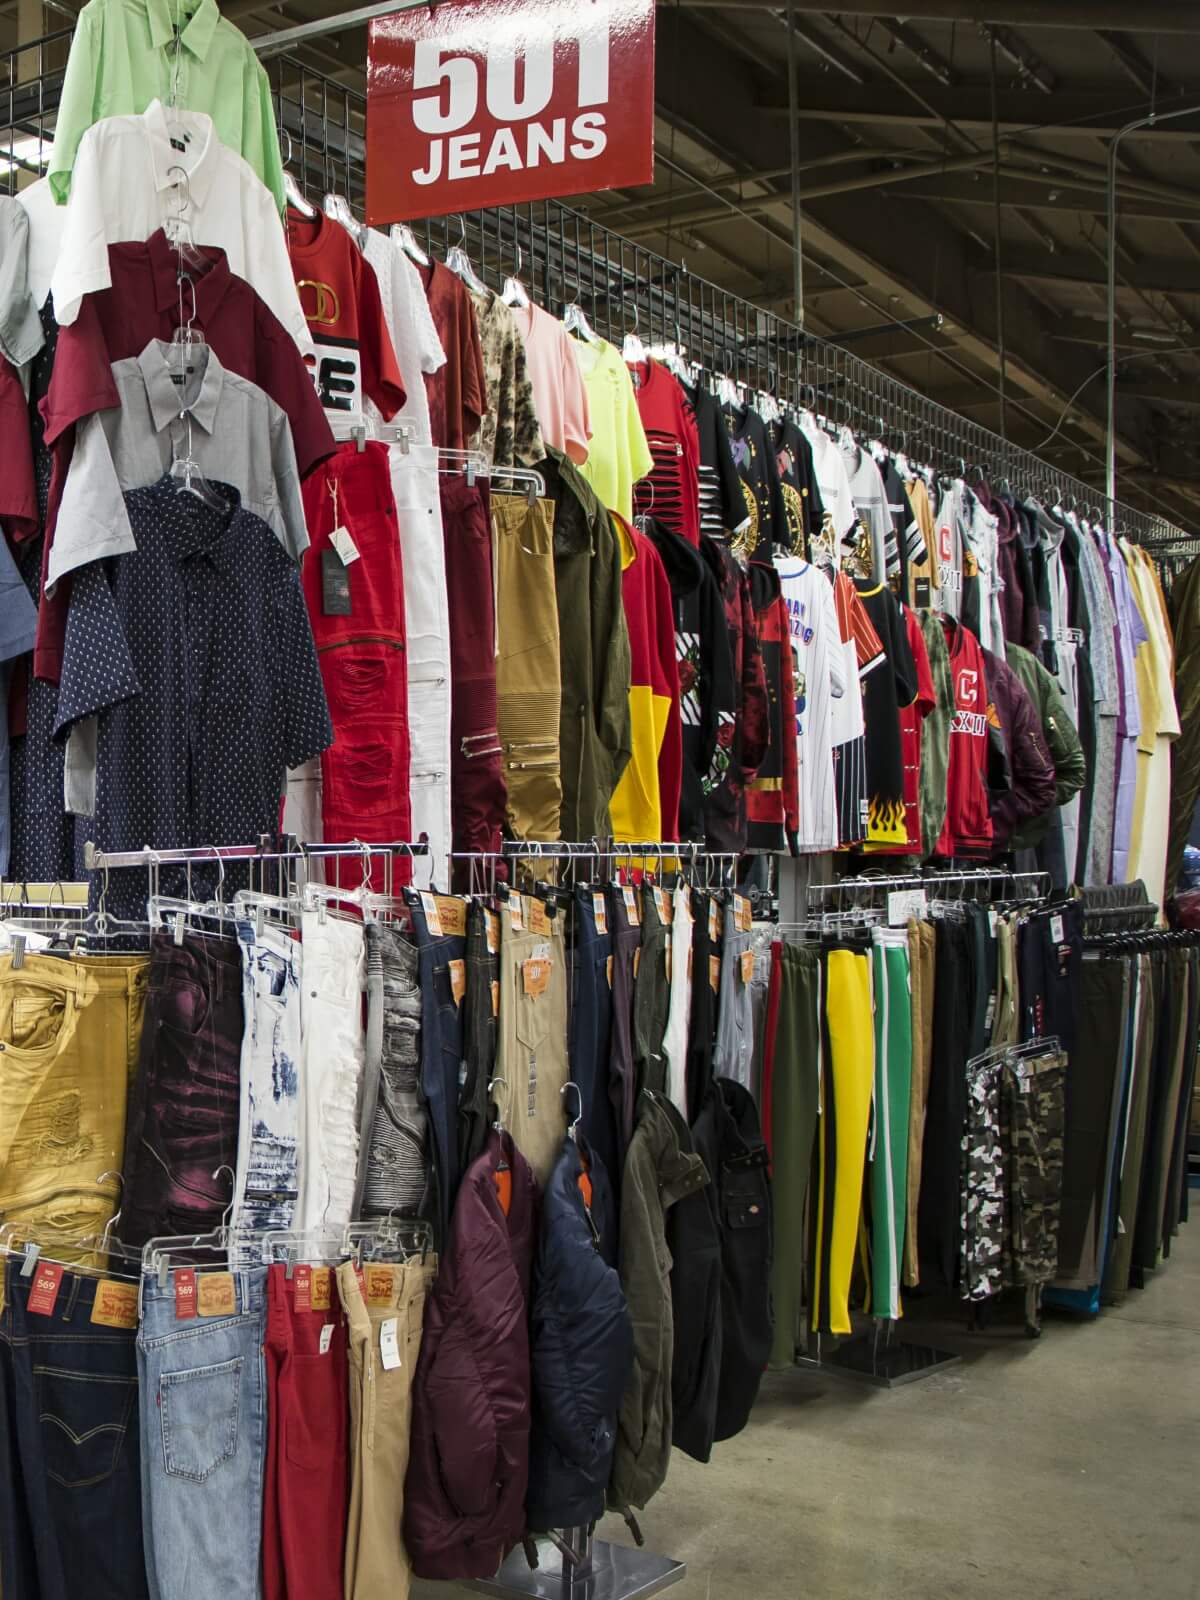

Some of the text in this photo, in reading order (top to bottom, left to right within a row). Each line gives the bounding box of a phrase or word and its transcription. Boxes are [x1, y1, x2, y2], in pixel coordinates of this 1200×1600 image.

[412, 8, 609, 134] 501
[411, 112, 607, 185] JEANS
[956, 668, 977, 707] C
[37, 1279, 56, 1291] 569
